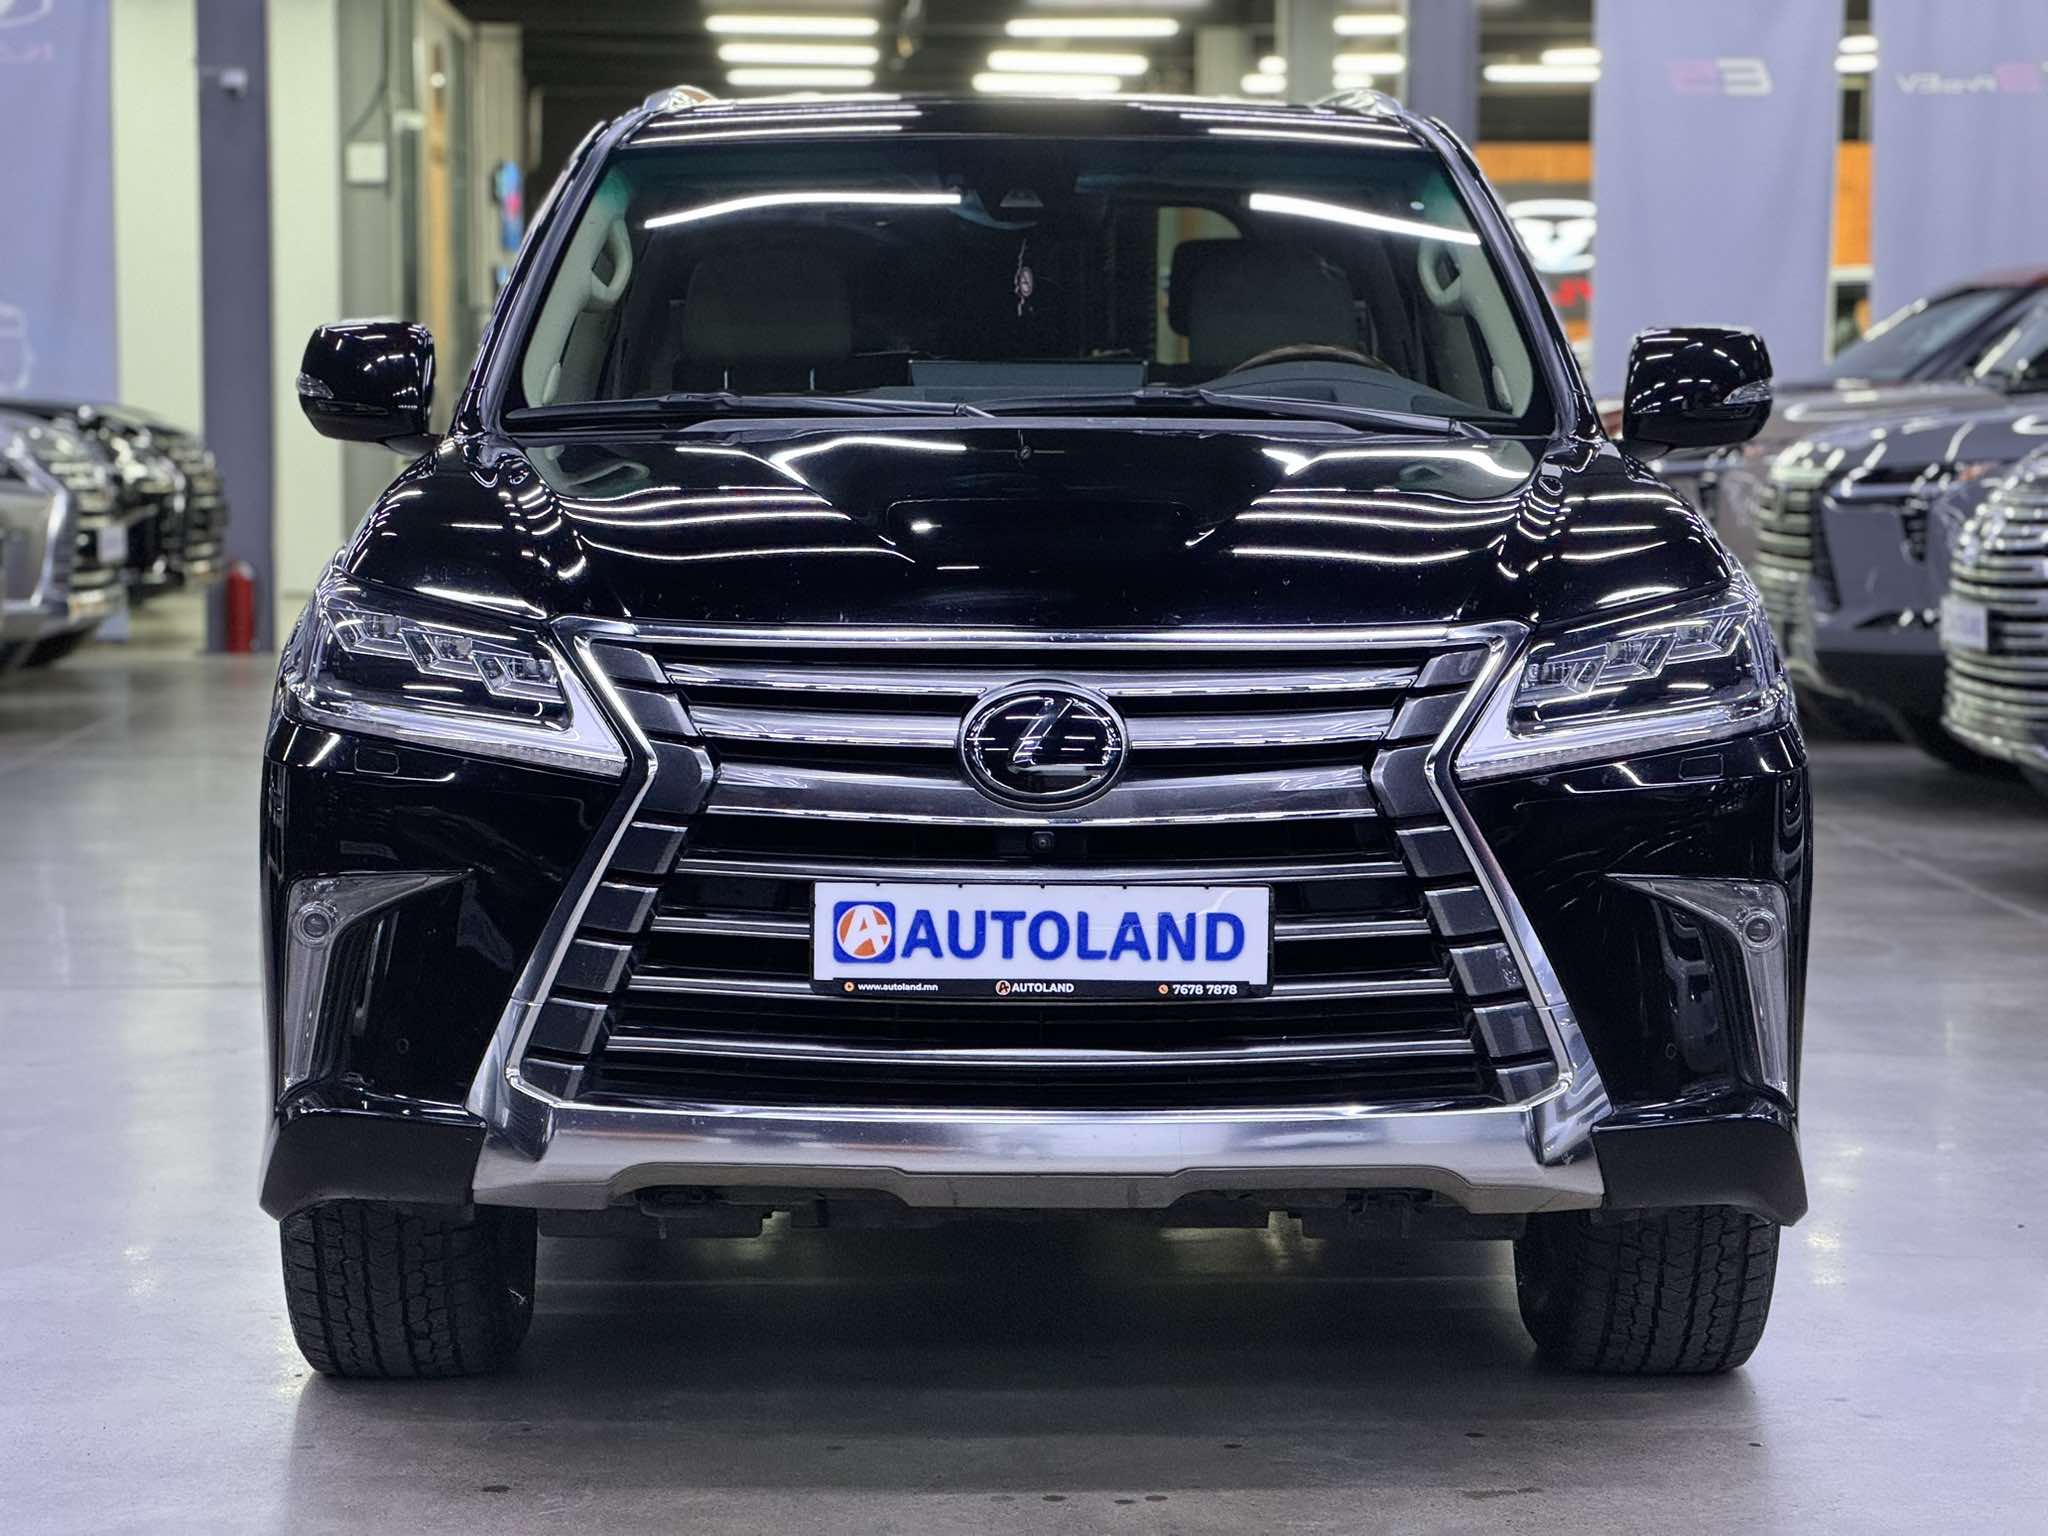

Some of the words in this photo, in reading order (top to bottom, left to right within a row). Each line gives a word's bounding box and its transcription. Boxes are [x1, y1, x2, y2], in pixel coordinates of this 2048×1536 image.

[901, 908, 1246, 962] AUTOLAND
[857, 981, 939, 992] www.autoland.mn
[1012, 982, 1075, 993] AUTOLAND
[1172, 984, 1204, 995] 7678
[1206, 984, 1238, 995] 7878
